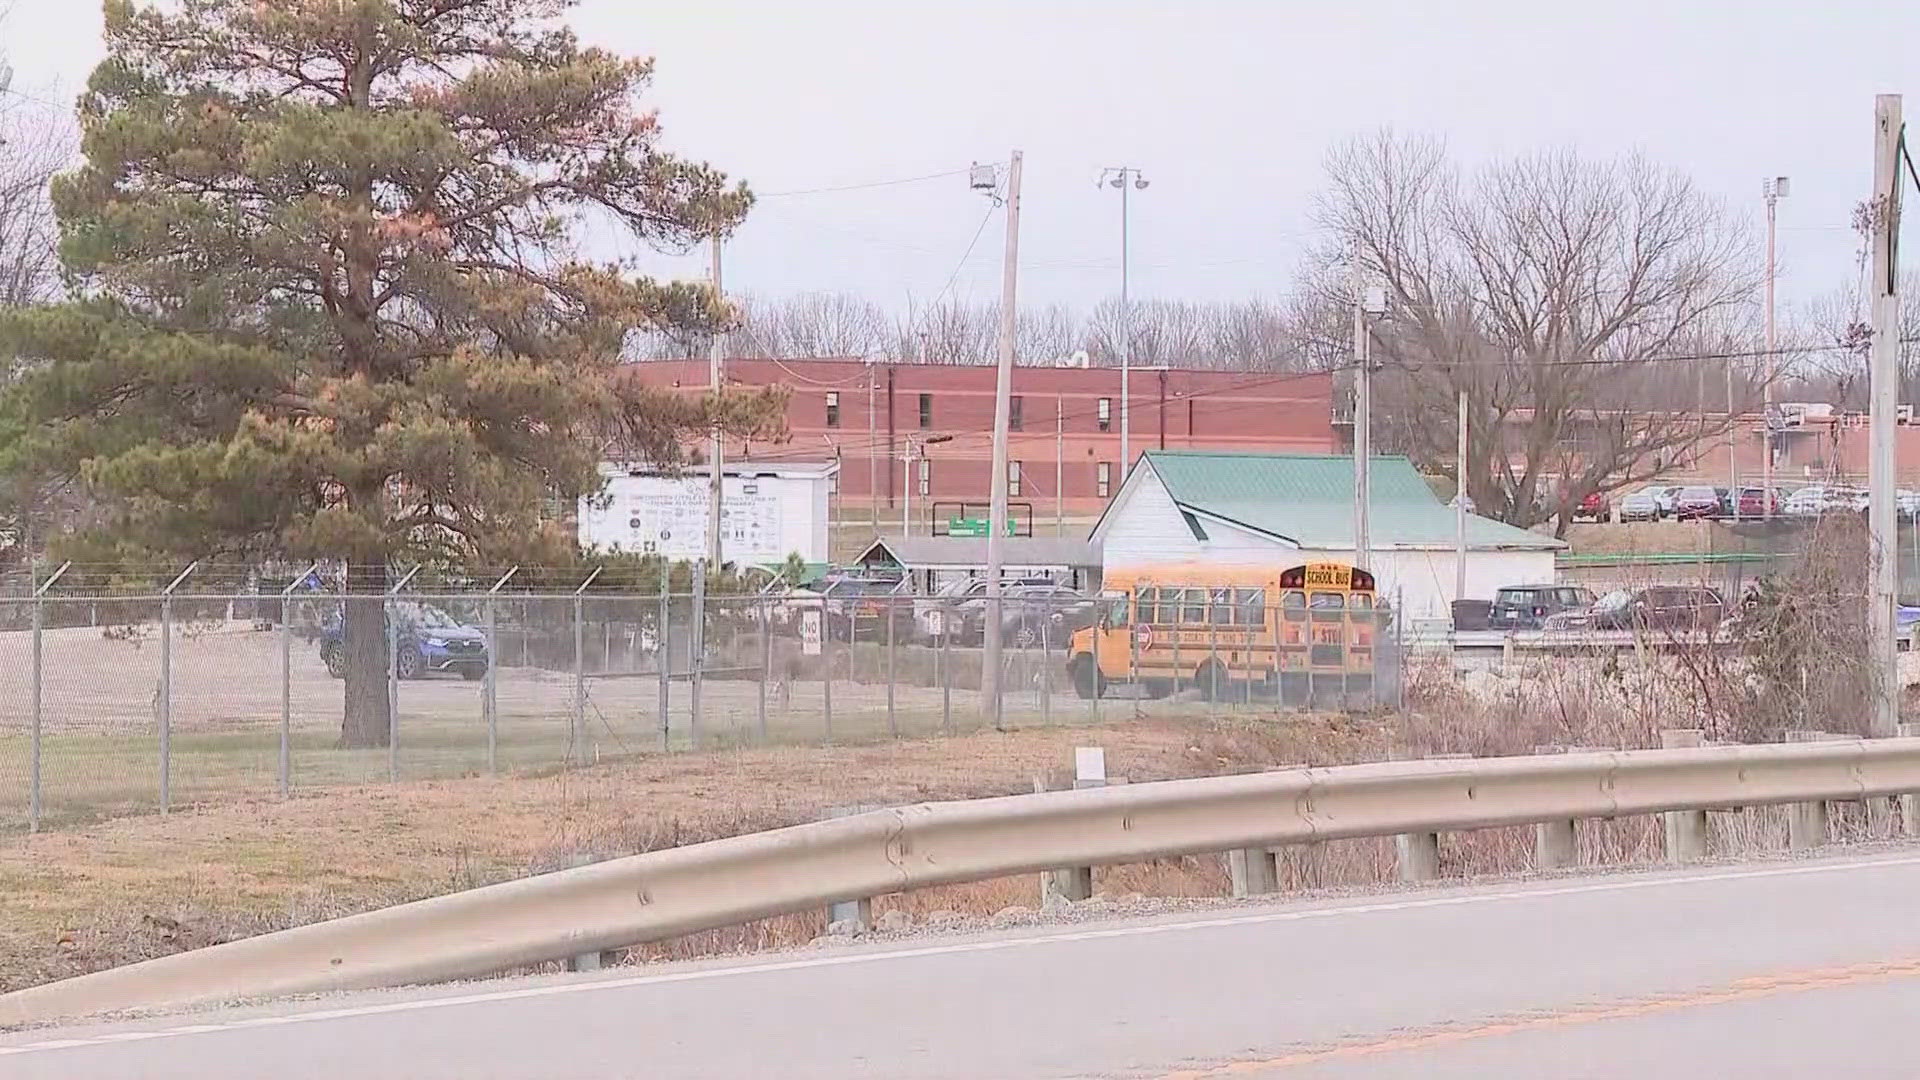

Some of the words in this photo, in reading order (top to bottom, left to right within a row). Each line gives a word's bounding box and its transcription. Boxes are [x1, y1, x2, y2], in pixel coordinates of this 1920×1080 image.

[1307, 571, 1333, 584] SCHOOL
[1335, 572, 1349, 586] BUS
[804, 621, 817, 634] NO
